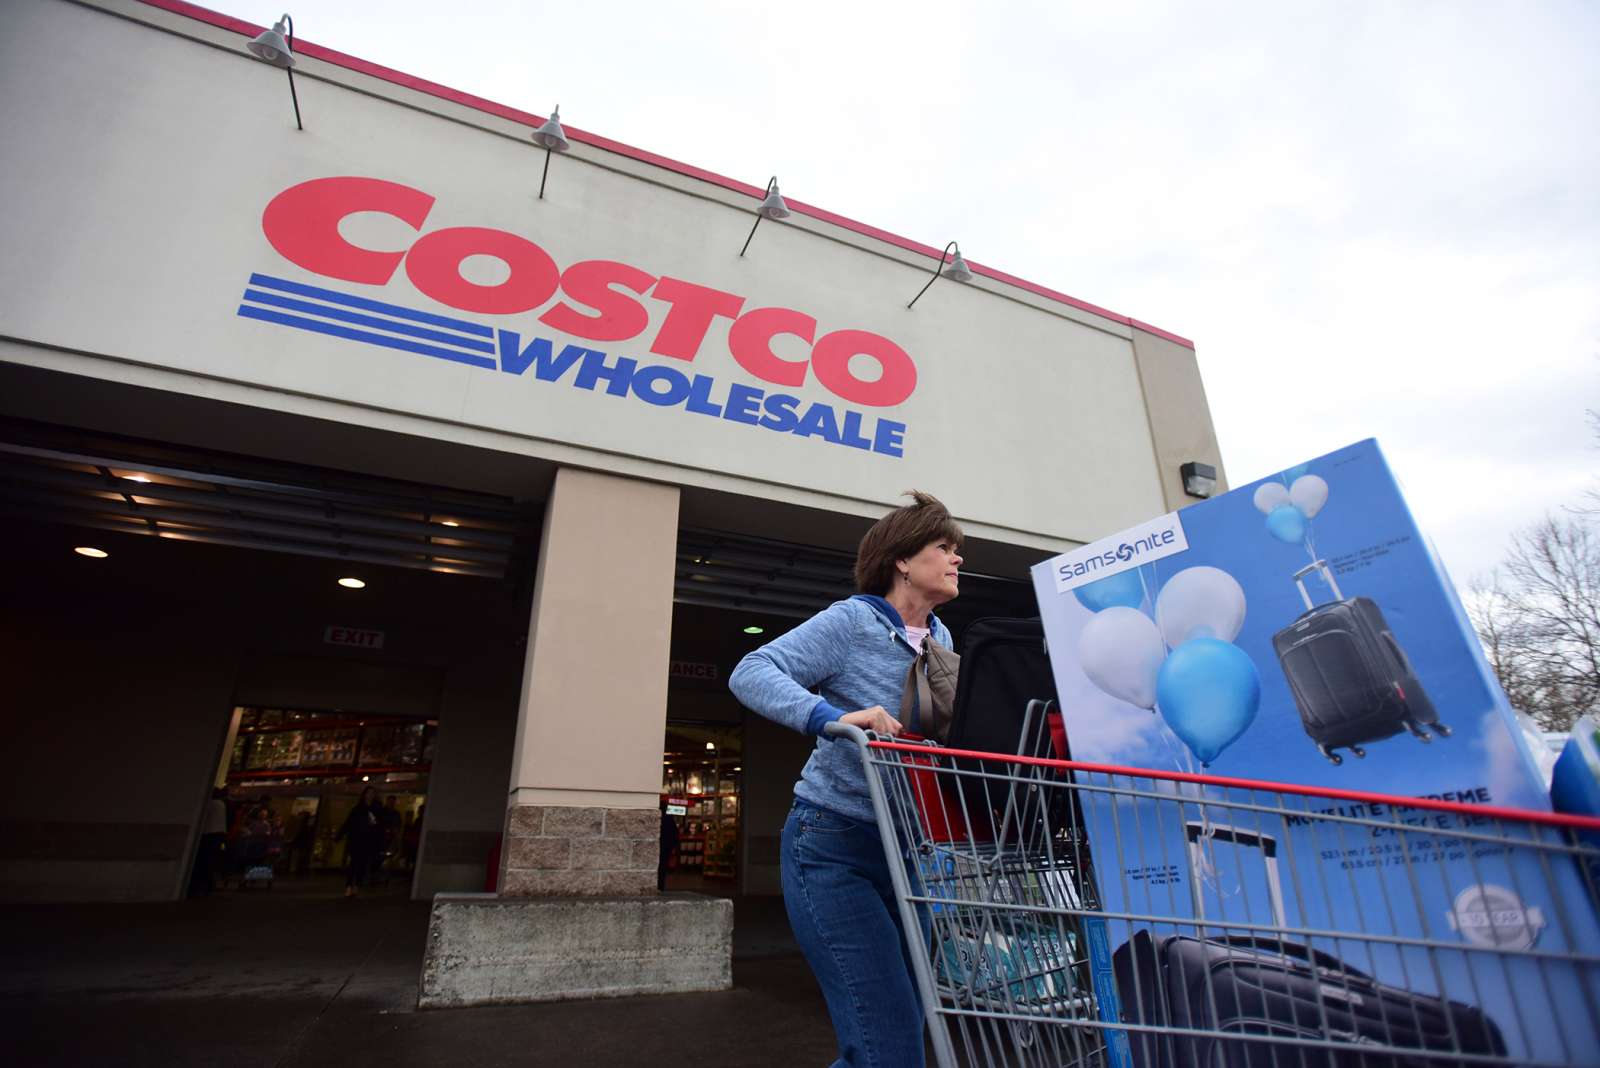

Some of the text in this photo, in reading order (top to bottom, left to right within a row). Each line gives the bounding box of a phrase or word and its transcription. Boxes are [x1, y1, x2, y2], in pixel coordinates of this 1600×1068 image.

[262, 176, 918, 408] COSTCO
[499, 328, 906, 458] WHOLESALE
[1060, 529, 1175, 581] Samsonite
[331, 629, 380, 645] EXIT
[671, 663, 715, 678] ANCE
